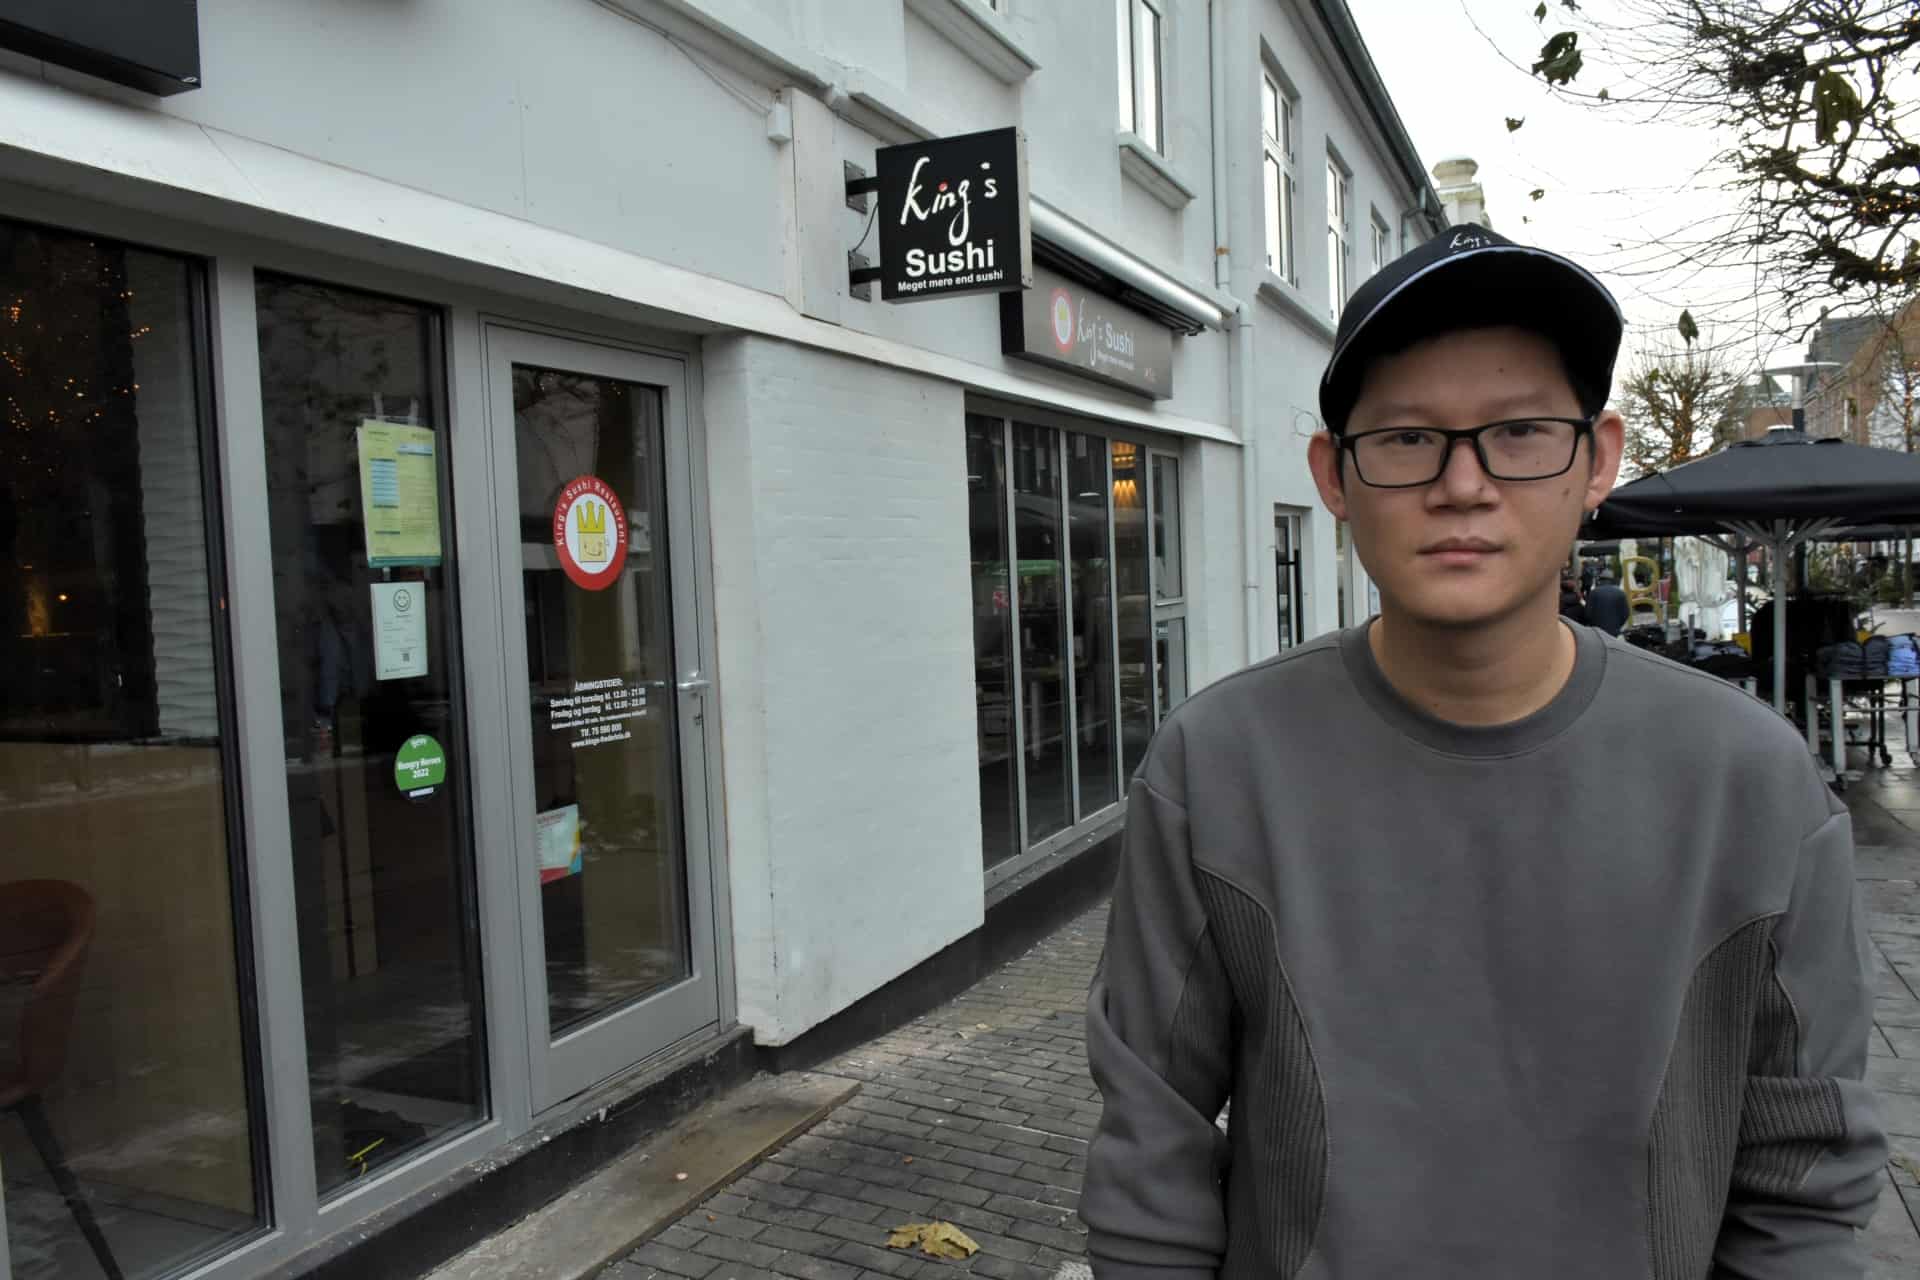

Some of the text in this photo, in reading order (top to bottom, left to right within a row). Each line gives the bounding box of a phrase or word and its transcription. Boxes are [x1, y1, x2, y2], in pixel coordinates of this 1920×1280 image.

[900, 156, 997, 246] King's
[905, 239, 994, 277] Sushi
[898, 269, 1003, 292] Meget mere end sushi
[1105, 322, 1135, 358] Sushi
[566, 479, 591, 500] Sushi
[594, 481, 625, 544] Restaurant
[573, 708, 582, 717] og
